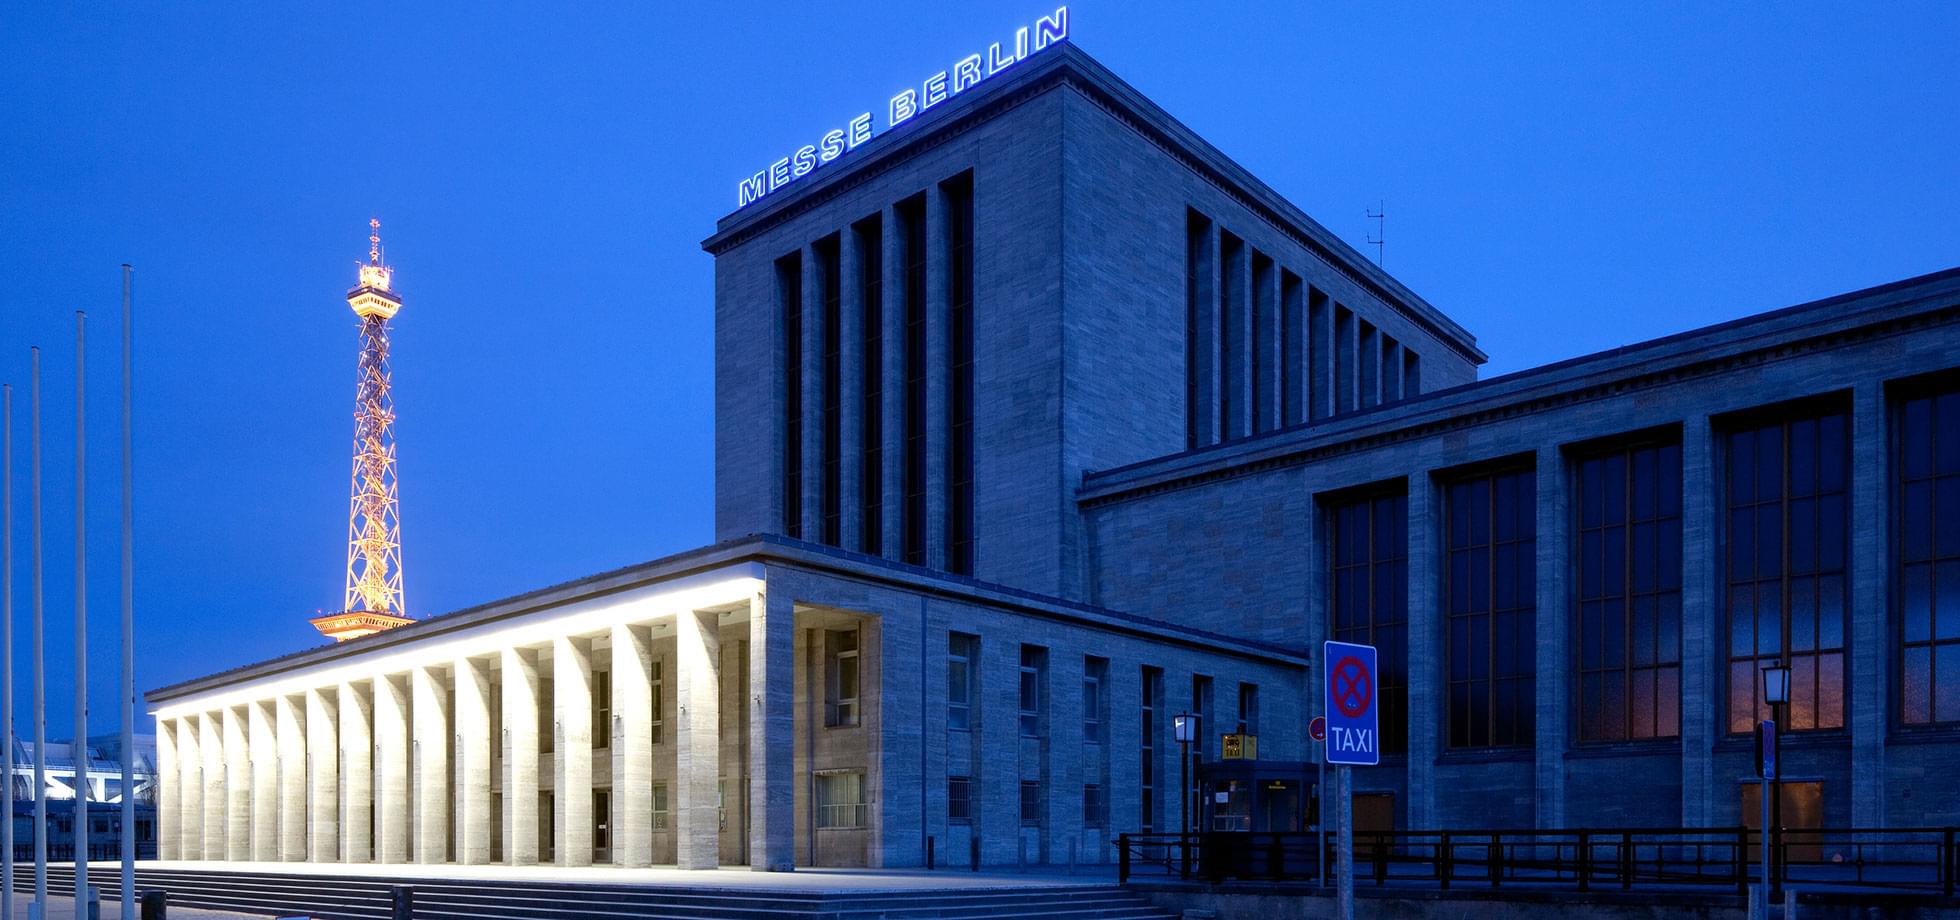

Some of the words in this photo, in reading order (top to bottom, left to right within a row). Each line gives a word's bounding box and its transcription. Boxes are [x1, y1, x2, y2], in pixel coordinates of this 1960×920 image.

[739, 111, 872, 207] MESSE
[889, 5, 1068, 127] BERLIN
[1331, 726, 1373, 753] TAXI
